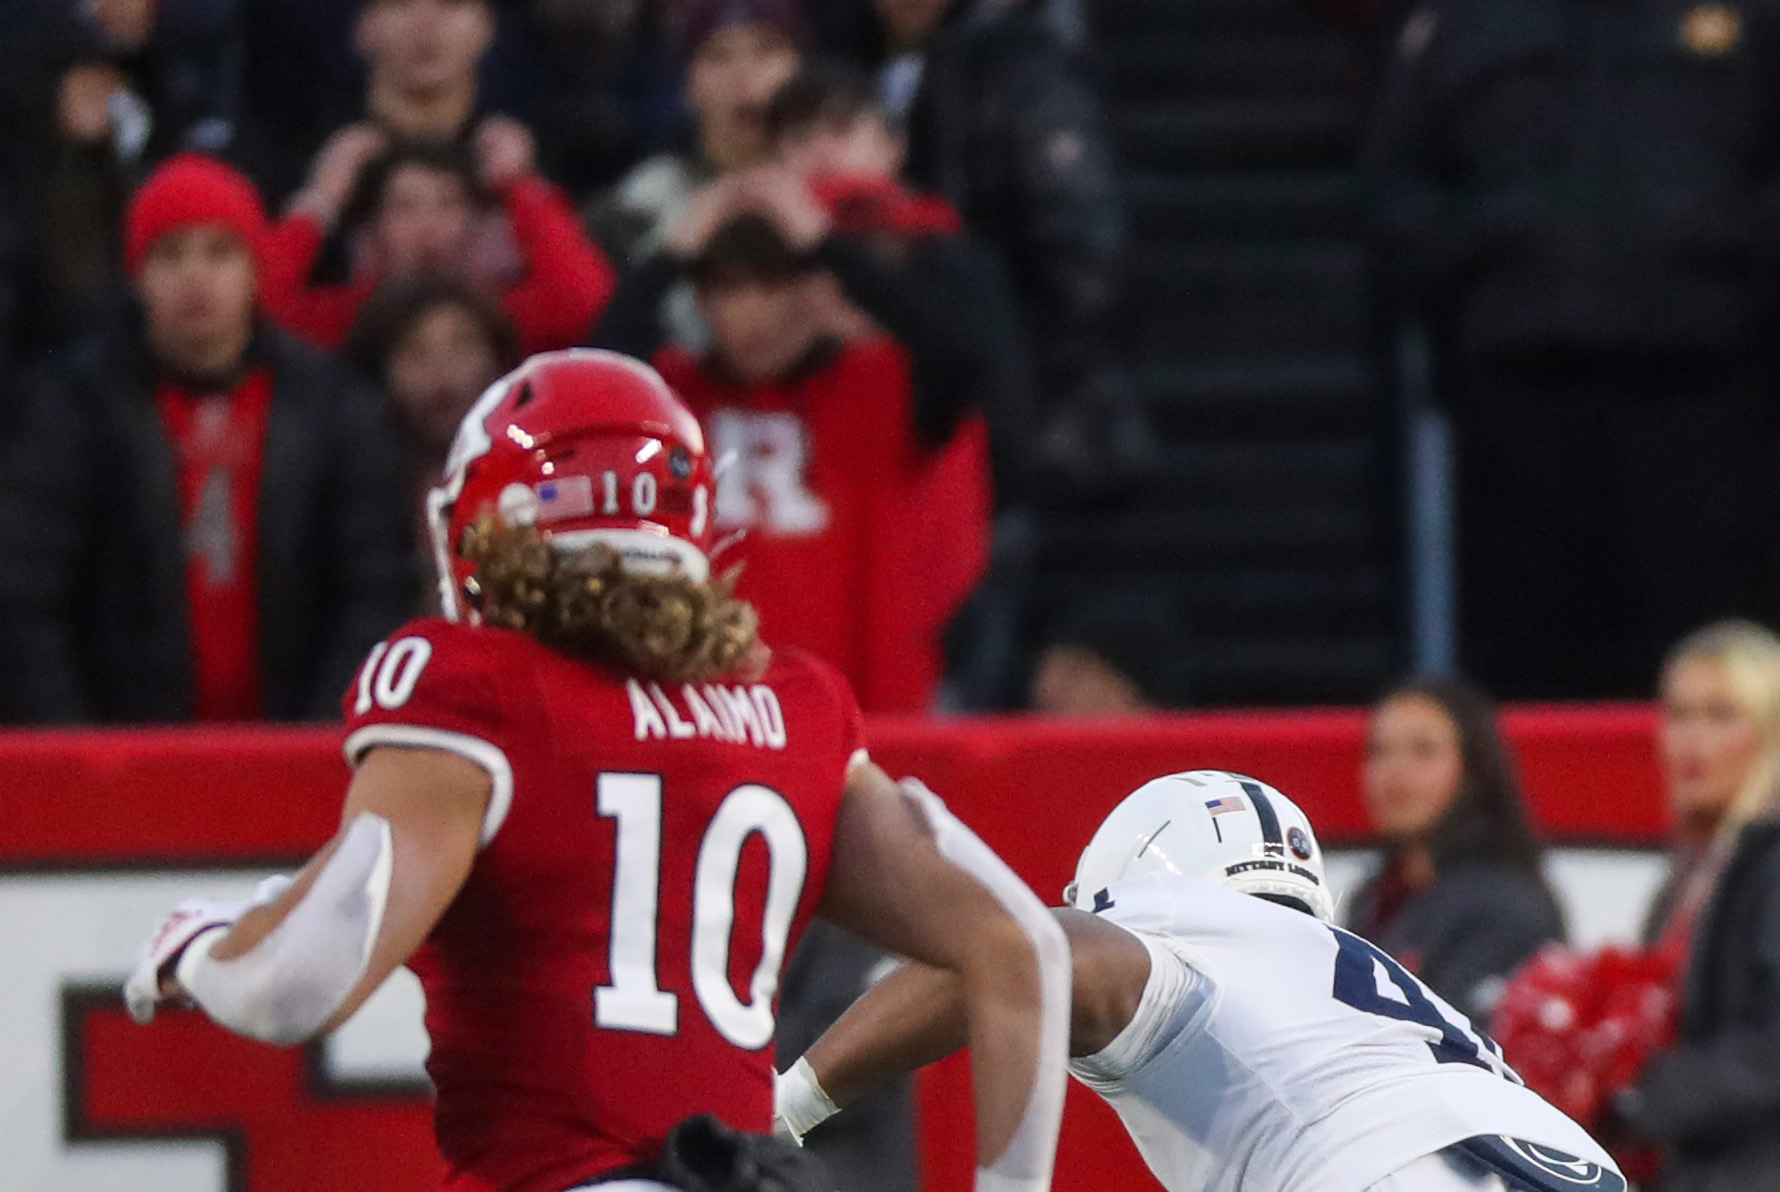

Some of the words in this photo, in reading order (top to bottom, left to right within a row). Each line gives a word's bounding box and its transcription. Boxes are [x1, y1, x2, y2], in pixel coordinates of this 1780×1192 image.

[603, 470, 657, 516] 10
[354, 636, 433, 716] 10
[627, 676, 787, 751] ALAIMO
[1225, 860, 1285, 877] NITTANY
[594, 771, 807, 1050] 10
